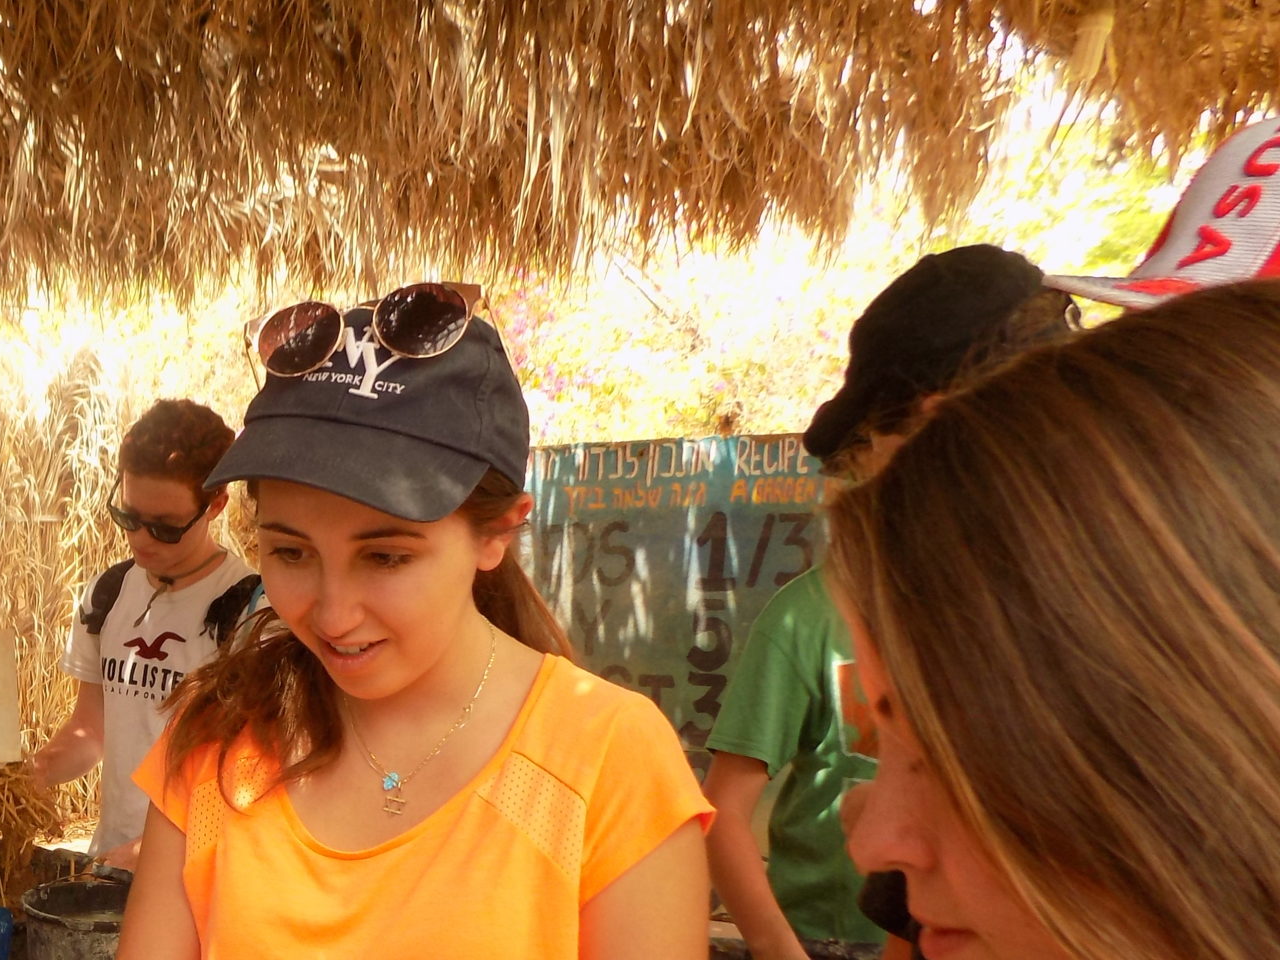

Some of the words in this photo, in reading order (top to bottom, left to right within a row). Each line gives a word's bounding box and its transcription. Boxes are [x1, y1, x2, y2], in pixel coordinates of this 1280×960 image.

[303, 371, 330, 383] NEW
[331, 372, 363, 386] YORK
[374, 380, 406, 395] CITY
[735, 436, 811, 477] RECIPE
[696, 512, 814, 591] 1/3
[686, 598, 733, 672] 5
[102, 657, 185, 692] HOLLISTE
